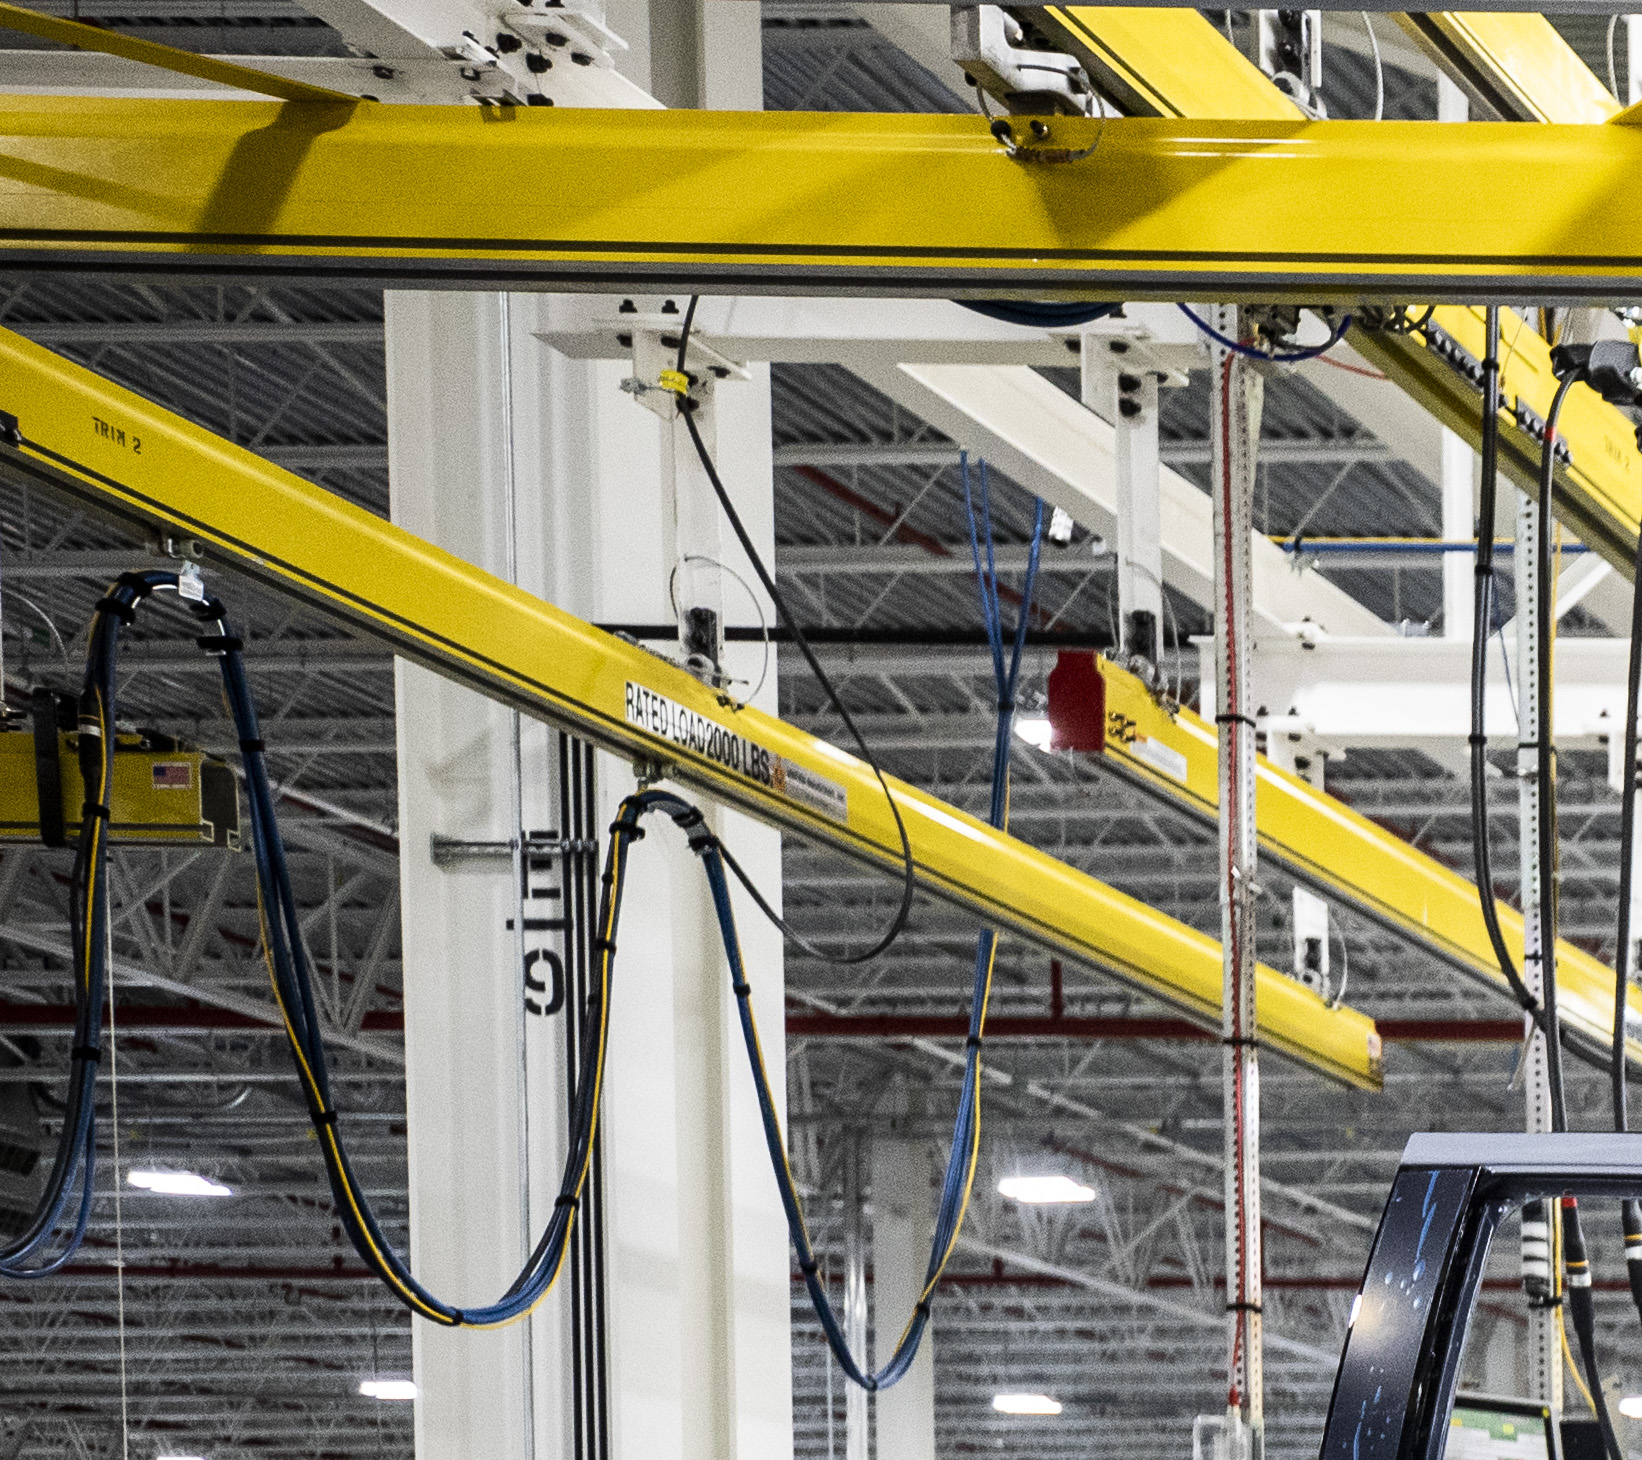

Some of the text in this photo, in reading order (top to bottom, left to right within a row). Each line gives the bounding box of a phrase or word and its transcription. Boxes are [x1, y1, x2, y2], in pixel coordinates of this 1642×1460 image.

[91, 416, 142, 455] TRIM 2
[626, 681, 771, 786] RATED LOAD 2000 LBS
